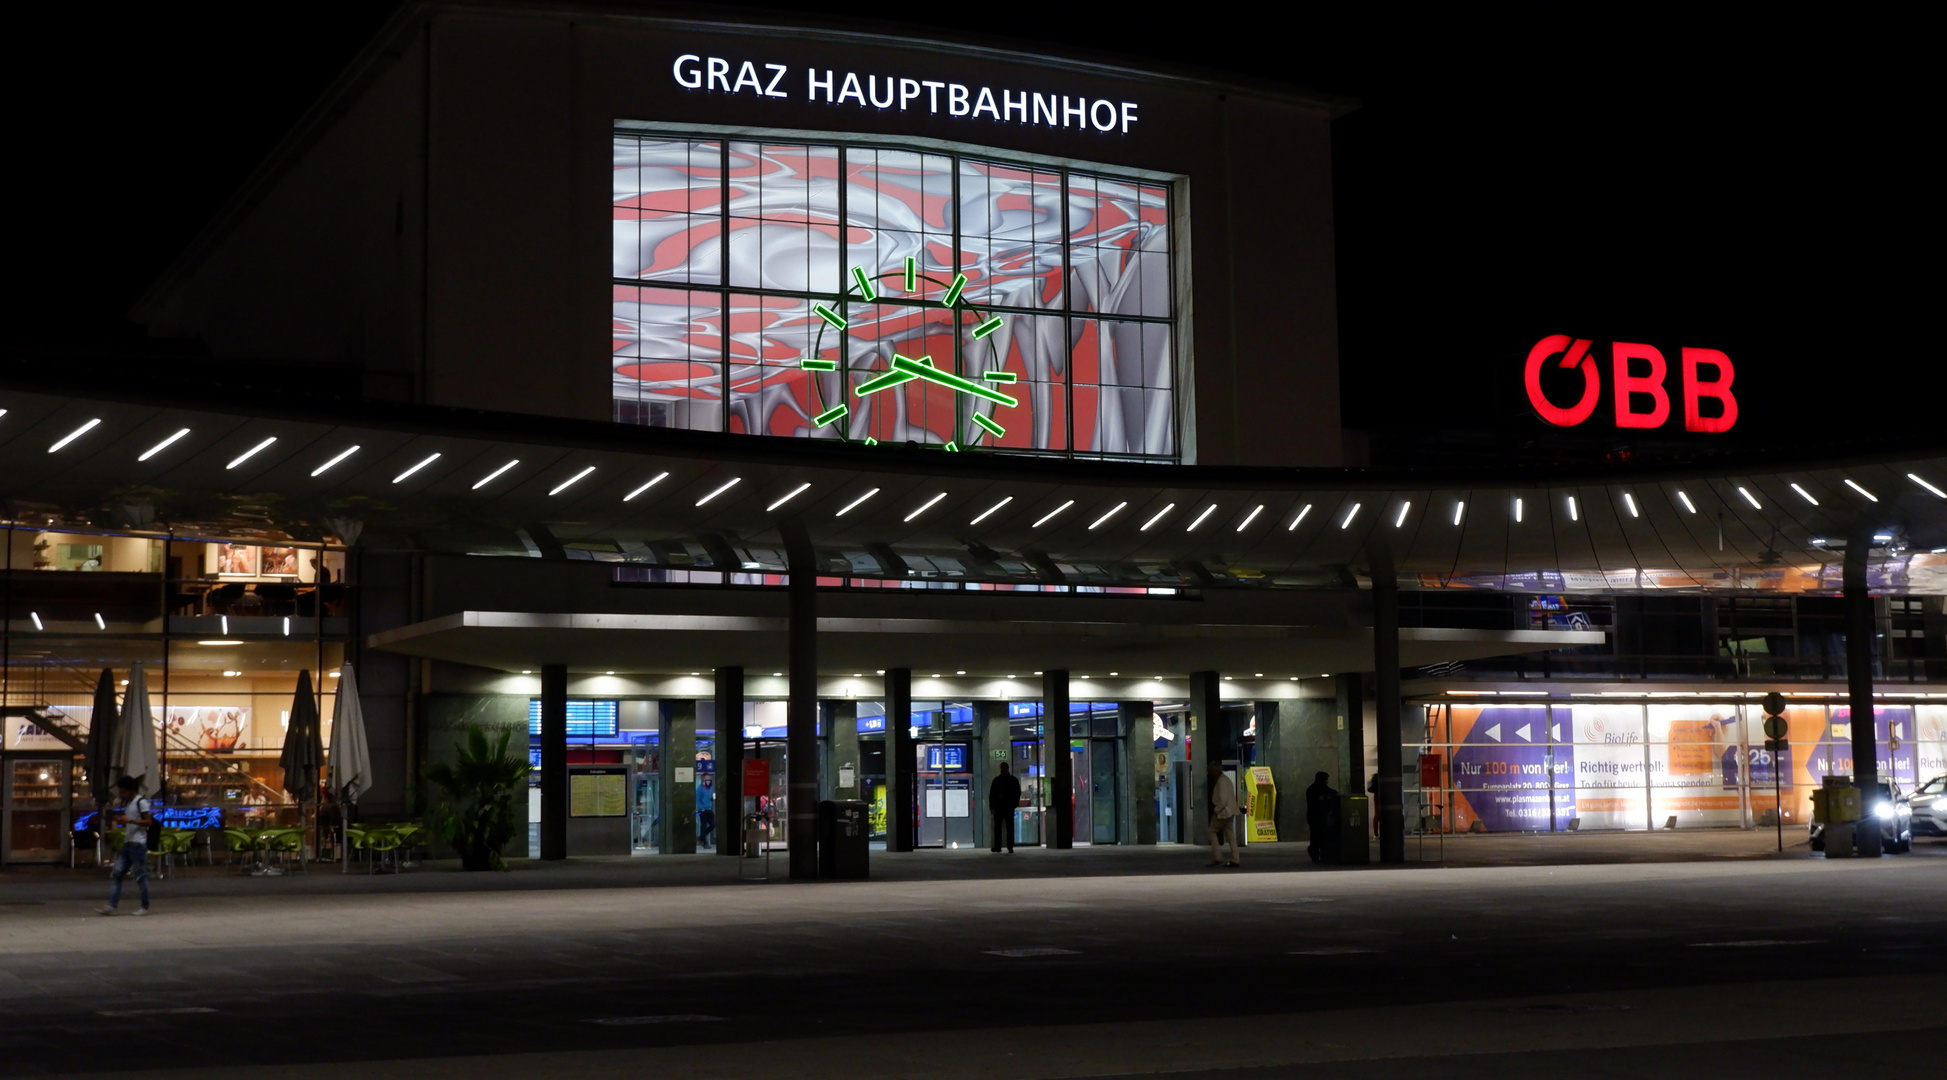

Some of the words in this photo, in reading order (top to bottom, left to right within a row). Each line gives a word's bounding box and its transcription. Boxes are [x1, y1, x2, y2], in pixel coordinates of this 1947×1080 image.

[673, 54, 788, 98] GRAZ
[808, 68, 1138, 134] HAUPTBAHNHOF
[1524, 334, 1739, 433] ÖBB
[1604, 732, 1638, 747] BioLife
[1461, 762, 1482, 775] Nur
[1485, 762, 1507, 775] 100
[1509, 764, 1520, 775] m
[1523, 764, 1541, 775] von
[1543, 761, 1568, 775] her!
[1580, 761, 1619, 775] Richtig
[1838, 758, 1853, 770] 10
[1920, 758, 1947, 769] Richt
[1648, 780, 1674, 788] lasma
[1677, 779, 1713, 790] spenden!
[1495, 794, 1570, 804] www.plasmazentm.at
